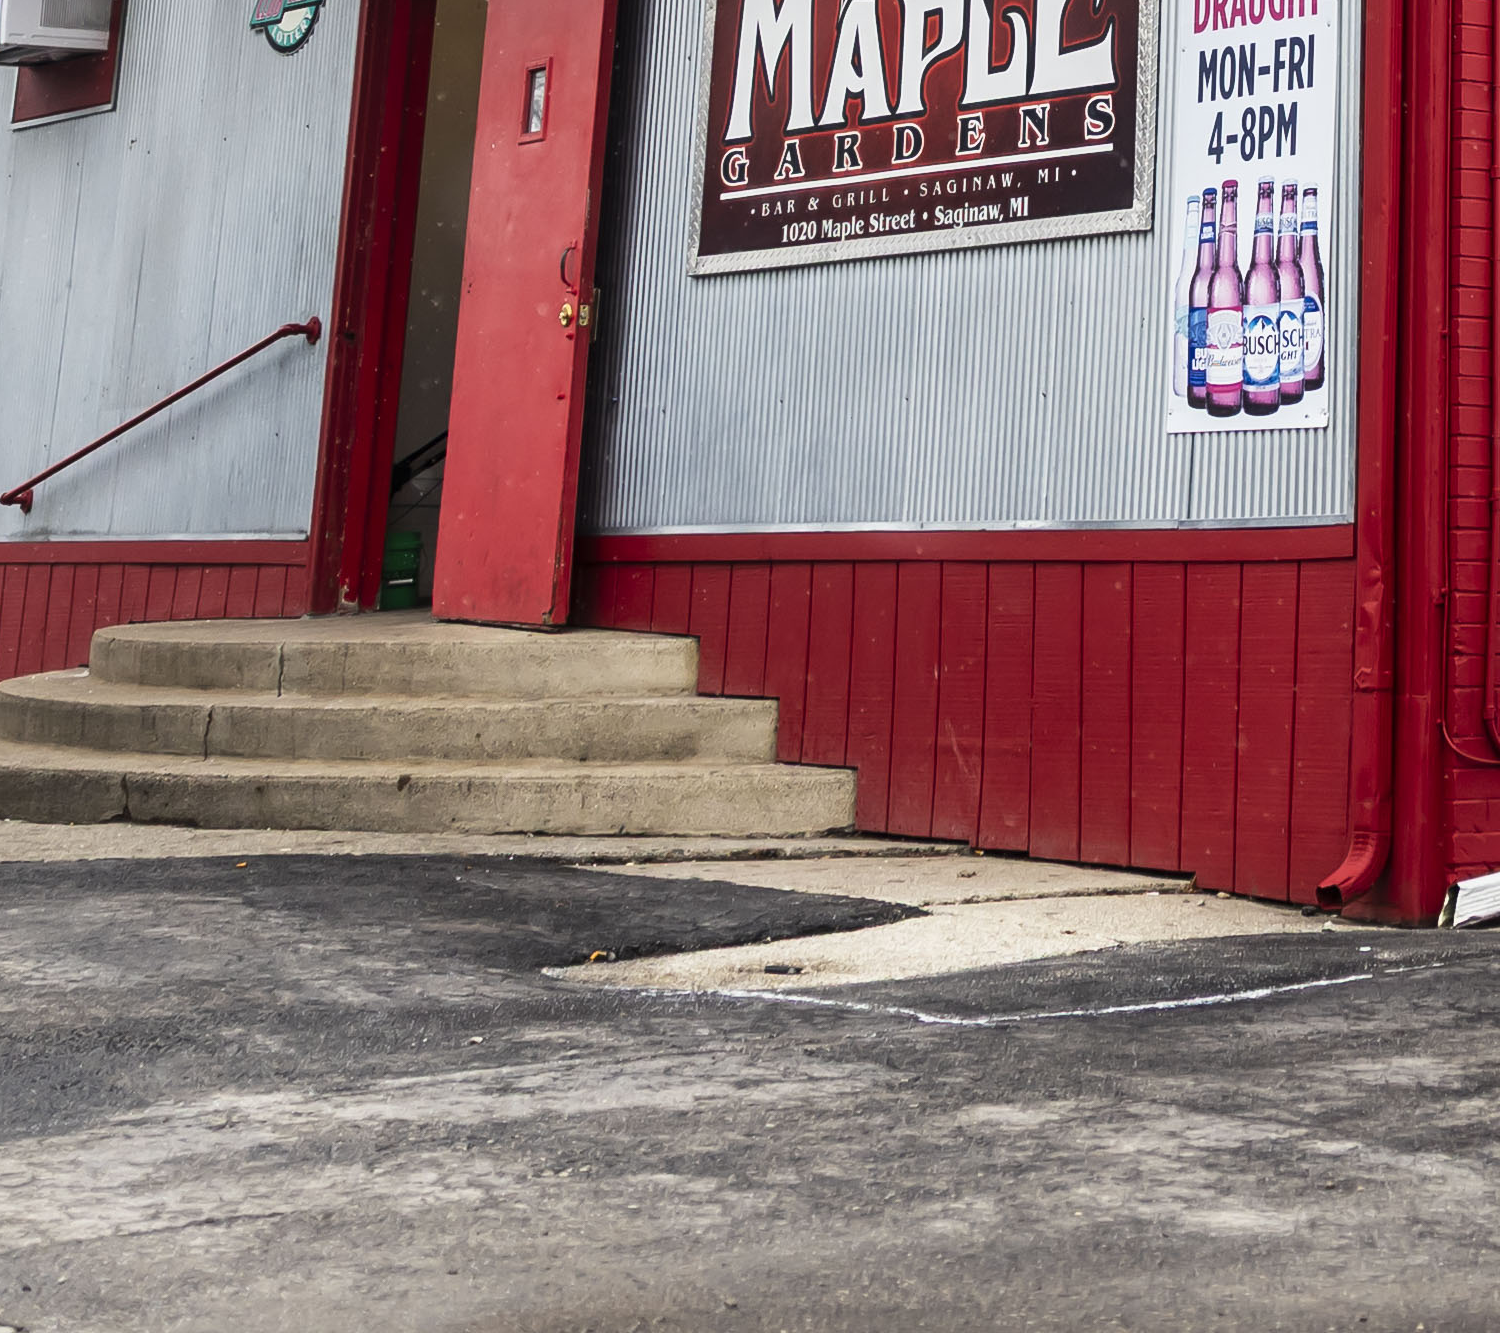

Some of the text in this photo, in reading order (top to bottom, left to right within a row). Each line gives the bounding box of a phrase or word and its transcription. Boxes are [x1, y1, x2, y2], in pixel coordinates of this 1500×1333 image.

[271, 6, 313, 46] LOTTERY
[1197, 33, 1315, 104] MON-FRI
[720, 95, 1115, 186] GARDENS
[1207, 101, 1298, 165] 4-8PM
[761, 167, 1060, 217] BAR & GRILL SAGINAW, MI
[781, 196, 1030, 243] 1020 Maple Street Saginaw, MI
[1242, 334, 1280, 356] BUSCH
[1280, 349, 1298, 361] GHT
[1282, 327, 1304, 348] SCH
